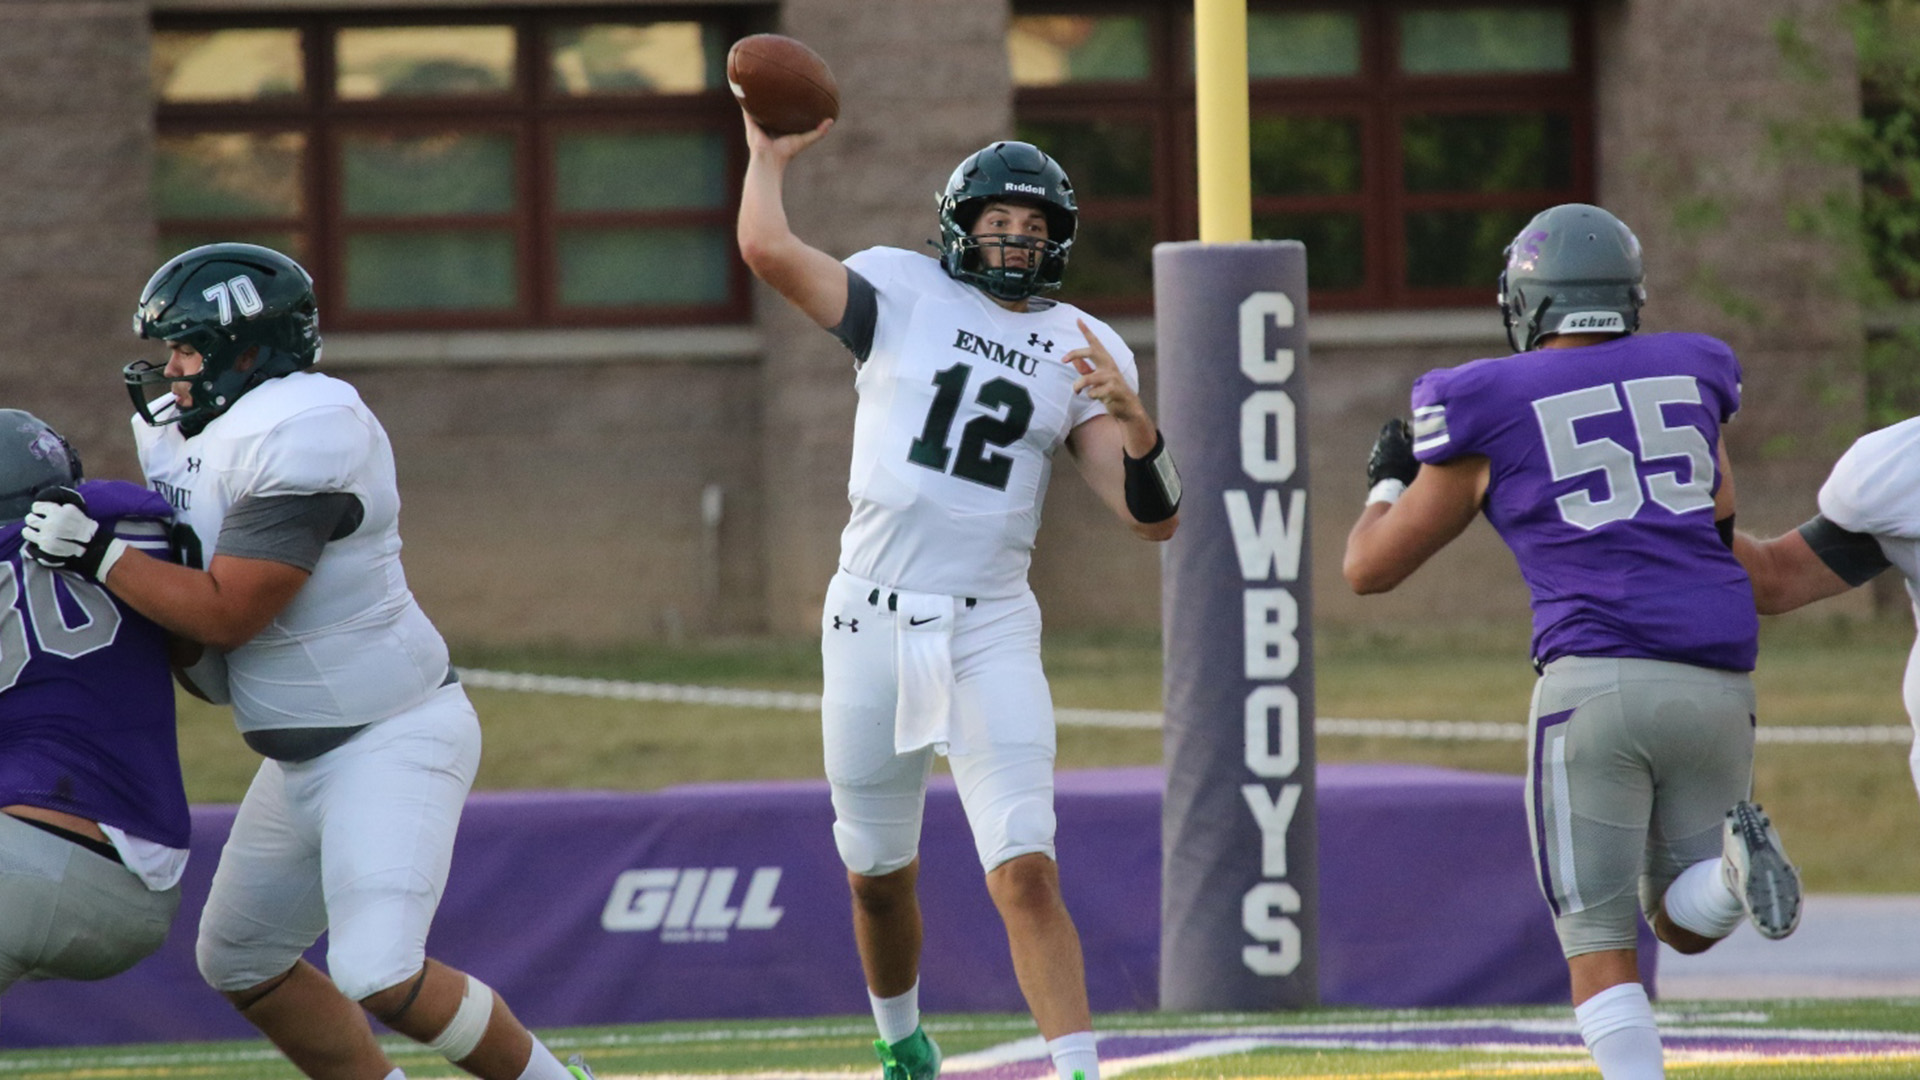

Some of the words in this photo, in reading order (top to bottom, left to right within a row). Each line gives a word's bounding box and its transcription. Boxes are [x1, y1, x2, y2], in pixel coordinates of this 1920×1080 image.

[1004, 182, 1046, 196] Riddell
[203, 274, 264, 326] 70
[1570, 315, 1619, 328] schutt
[906, 361, 1035, 492] 12
[1531, 375, 1716, 531] 55
[1223, 291, 1307, 977] COWBOYS
[602, 867, 784, 932] GILL
